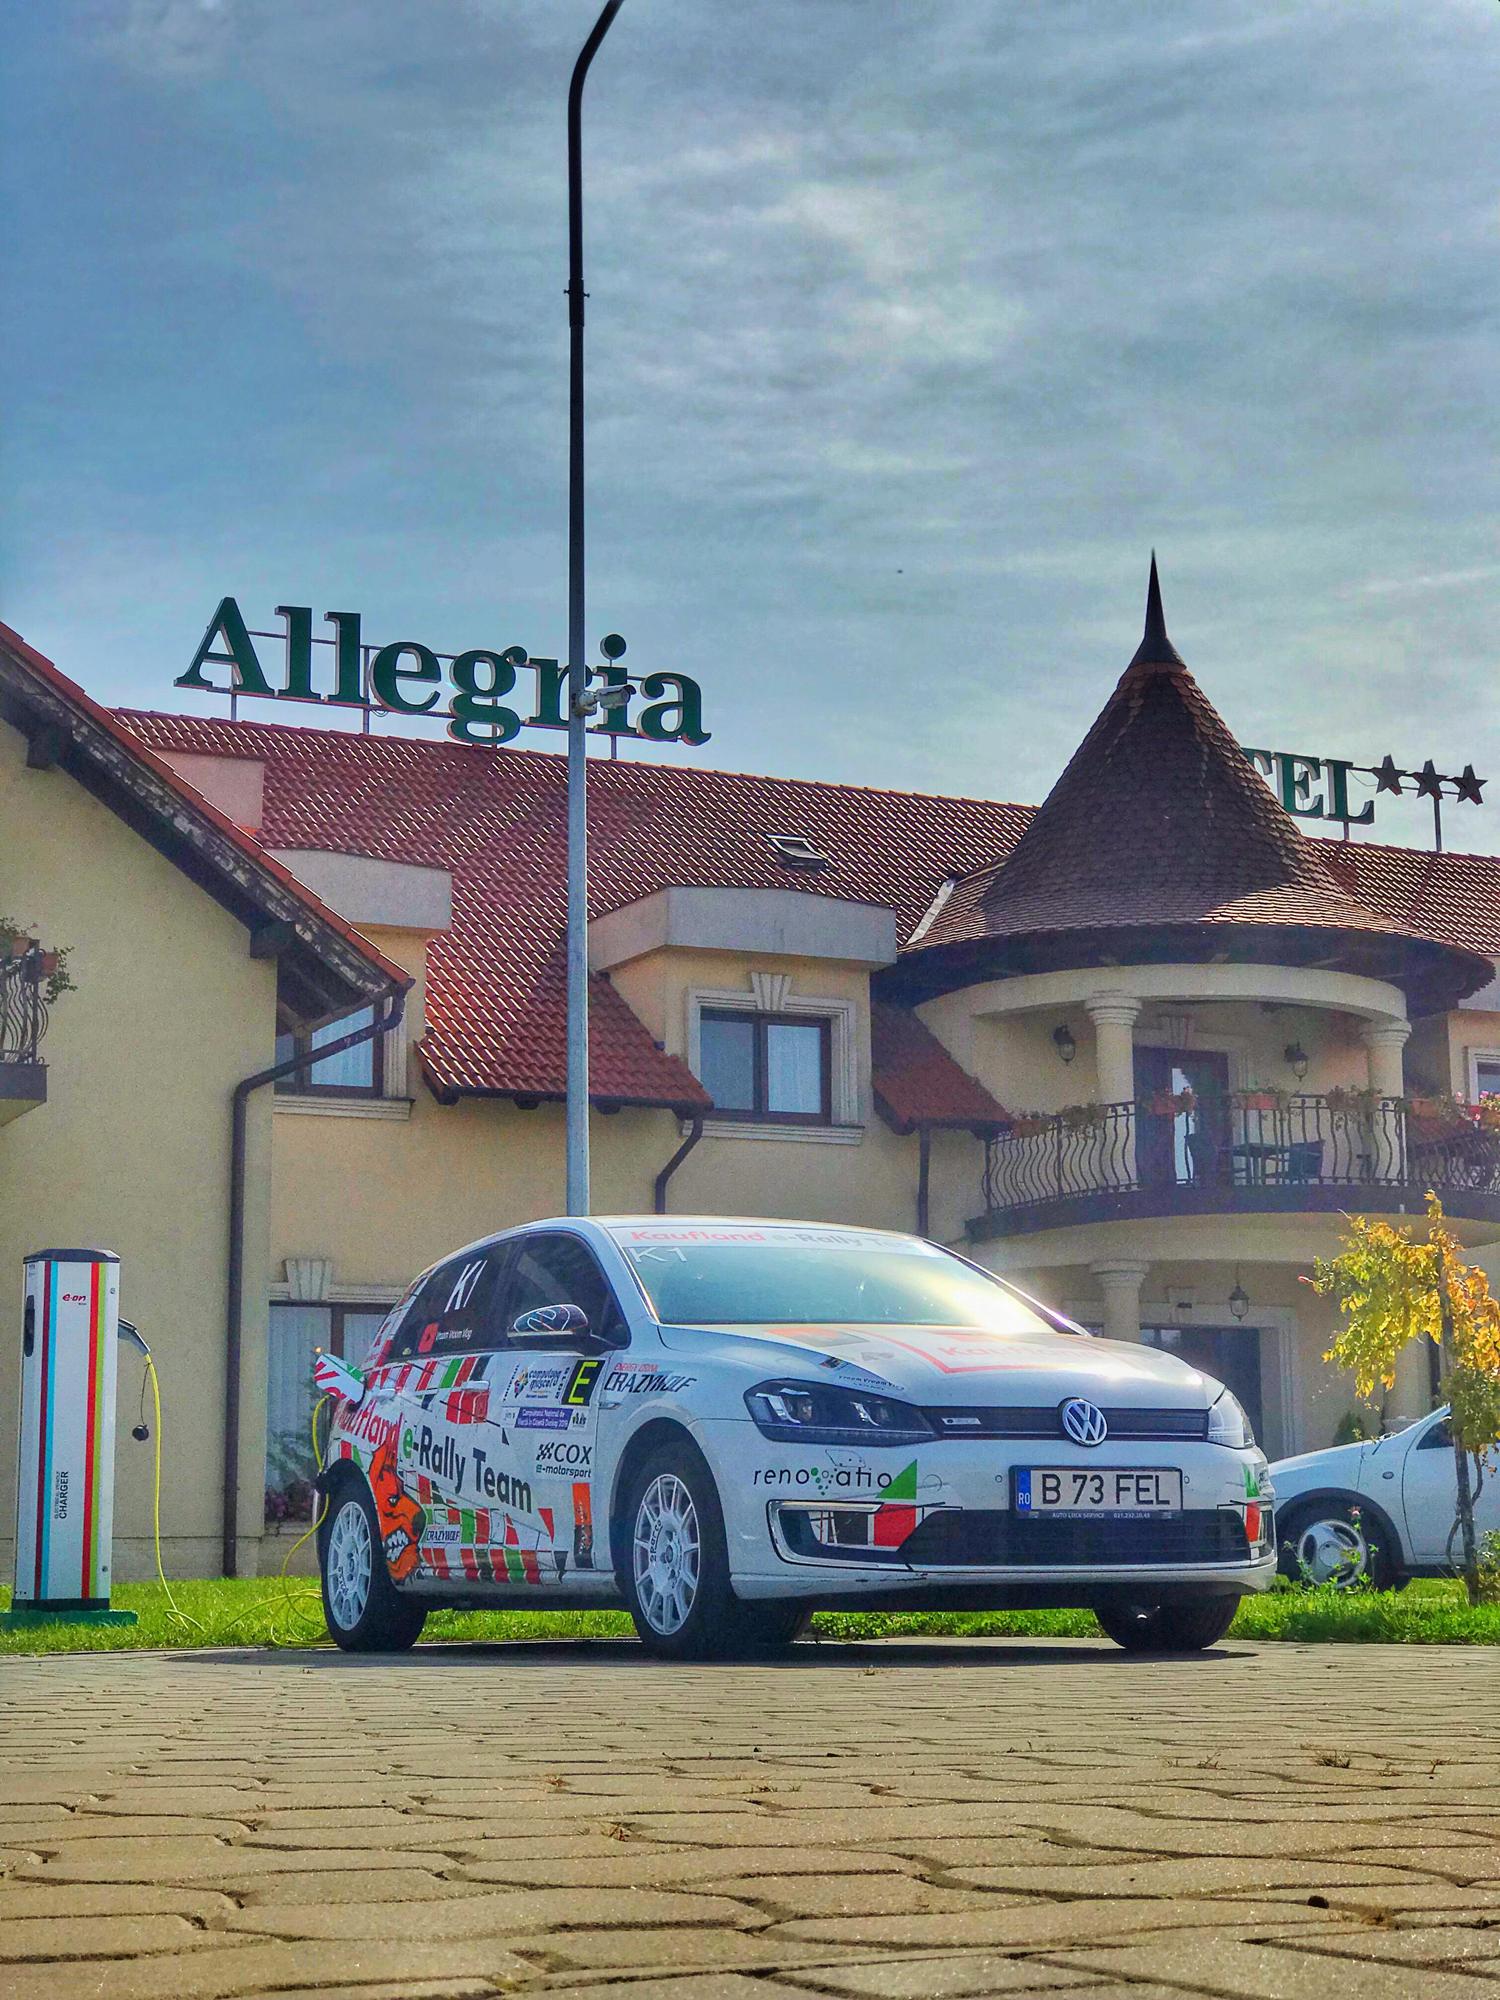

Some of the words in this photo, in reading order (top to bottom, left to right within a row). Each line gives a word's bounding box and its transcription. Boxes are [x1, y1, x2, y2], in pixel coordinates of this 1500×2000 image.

[173, 597, 711, 745] Allegria
[631, 1230, 766, 1242] Kaufland
[629, 1247, 688, 1264] K1
[444, 1260, 488, 1313] K1
[568, 1361, 599, 1404] E
[604, 1371, 697, 1394] CRAZYWOLF
[403, 1425, 466, 1493] e-Rally
[473, 1447, 532, 1514] Team
[554, 1443, 592, 1465] COX
[58, 1471, 69, 1520] CHARGER
[1018, 1492, 1031, 1505] RO
[1042, 1473, 1061, 1505] B
[1072, 1474, 1105, 1505] 73
[1115, 1474, 1170, 1506] FEL
